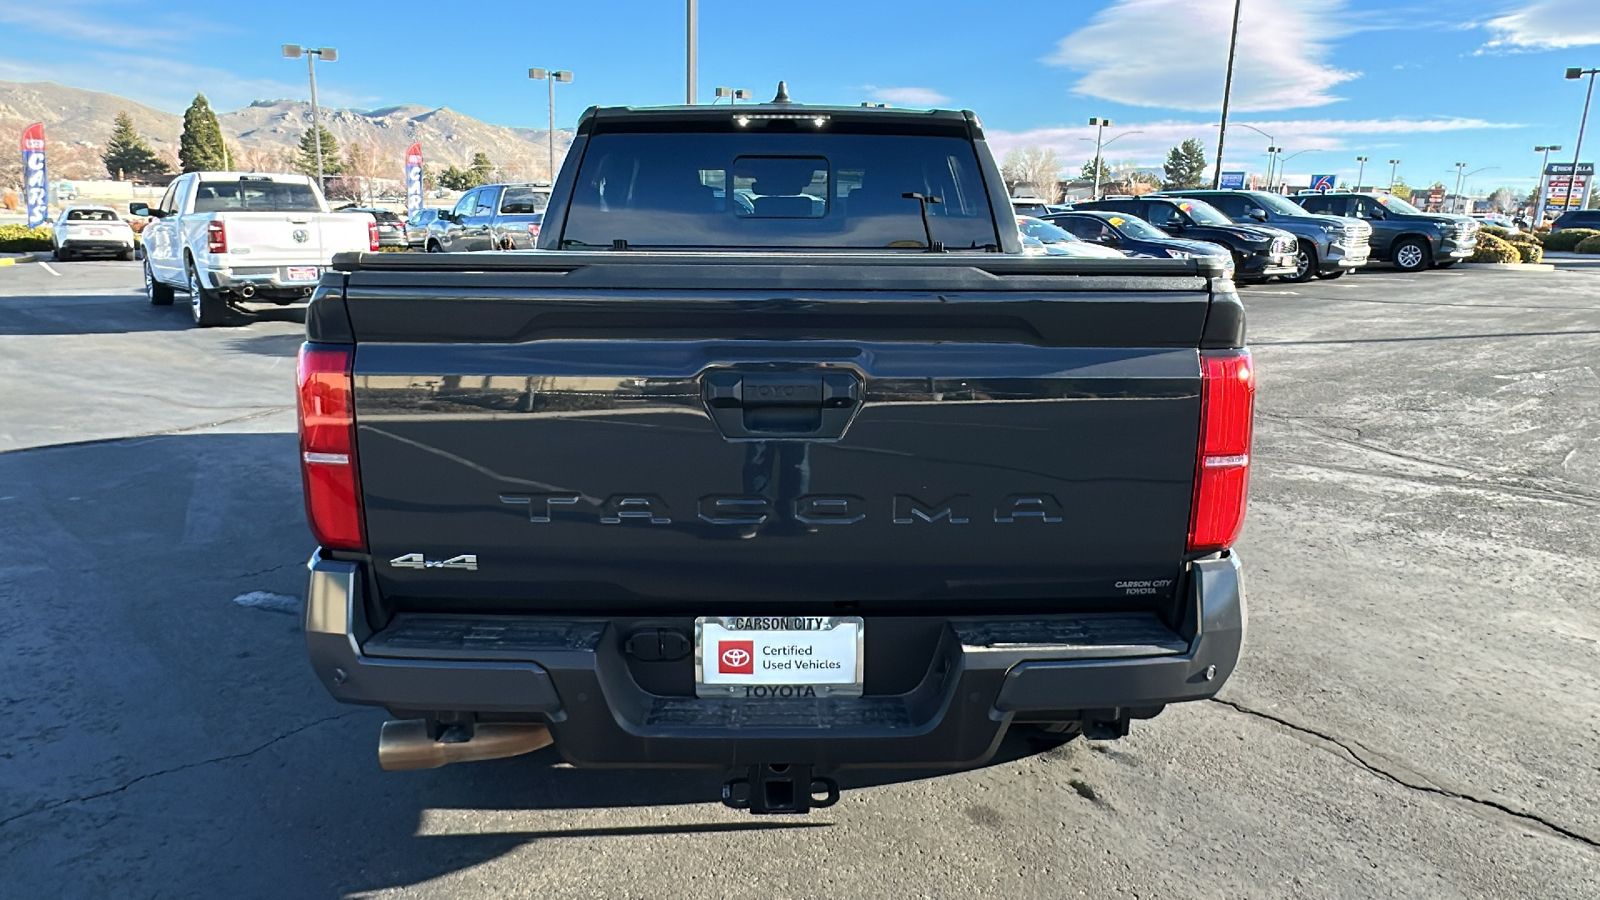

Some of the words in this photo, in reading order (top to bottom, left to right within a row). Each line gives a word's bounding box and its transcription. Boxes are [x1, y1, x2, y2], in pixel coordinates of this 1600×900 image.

[28, 152, 47, 222] CARS
[1315, 175, 1332, 190] 6
[499, 491, 1064, 525] TACOMA
[735, 617, 789, 630] CARSON
[794, 617, 823, 630] CITY
[762, 645, 812, 656] Certified
[762, 660, 792, 669] Used
[795, 659, 841, 669] Vehicles
[744, 685, 817, 698] TOYOTA
